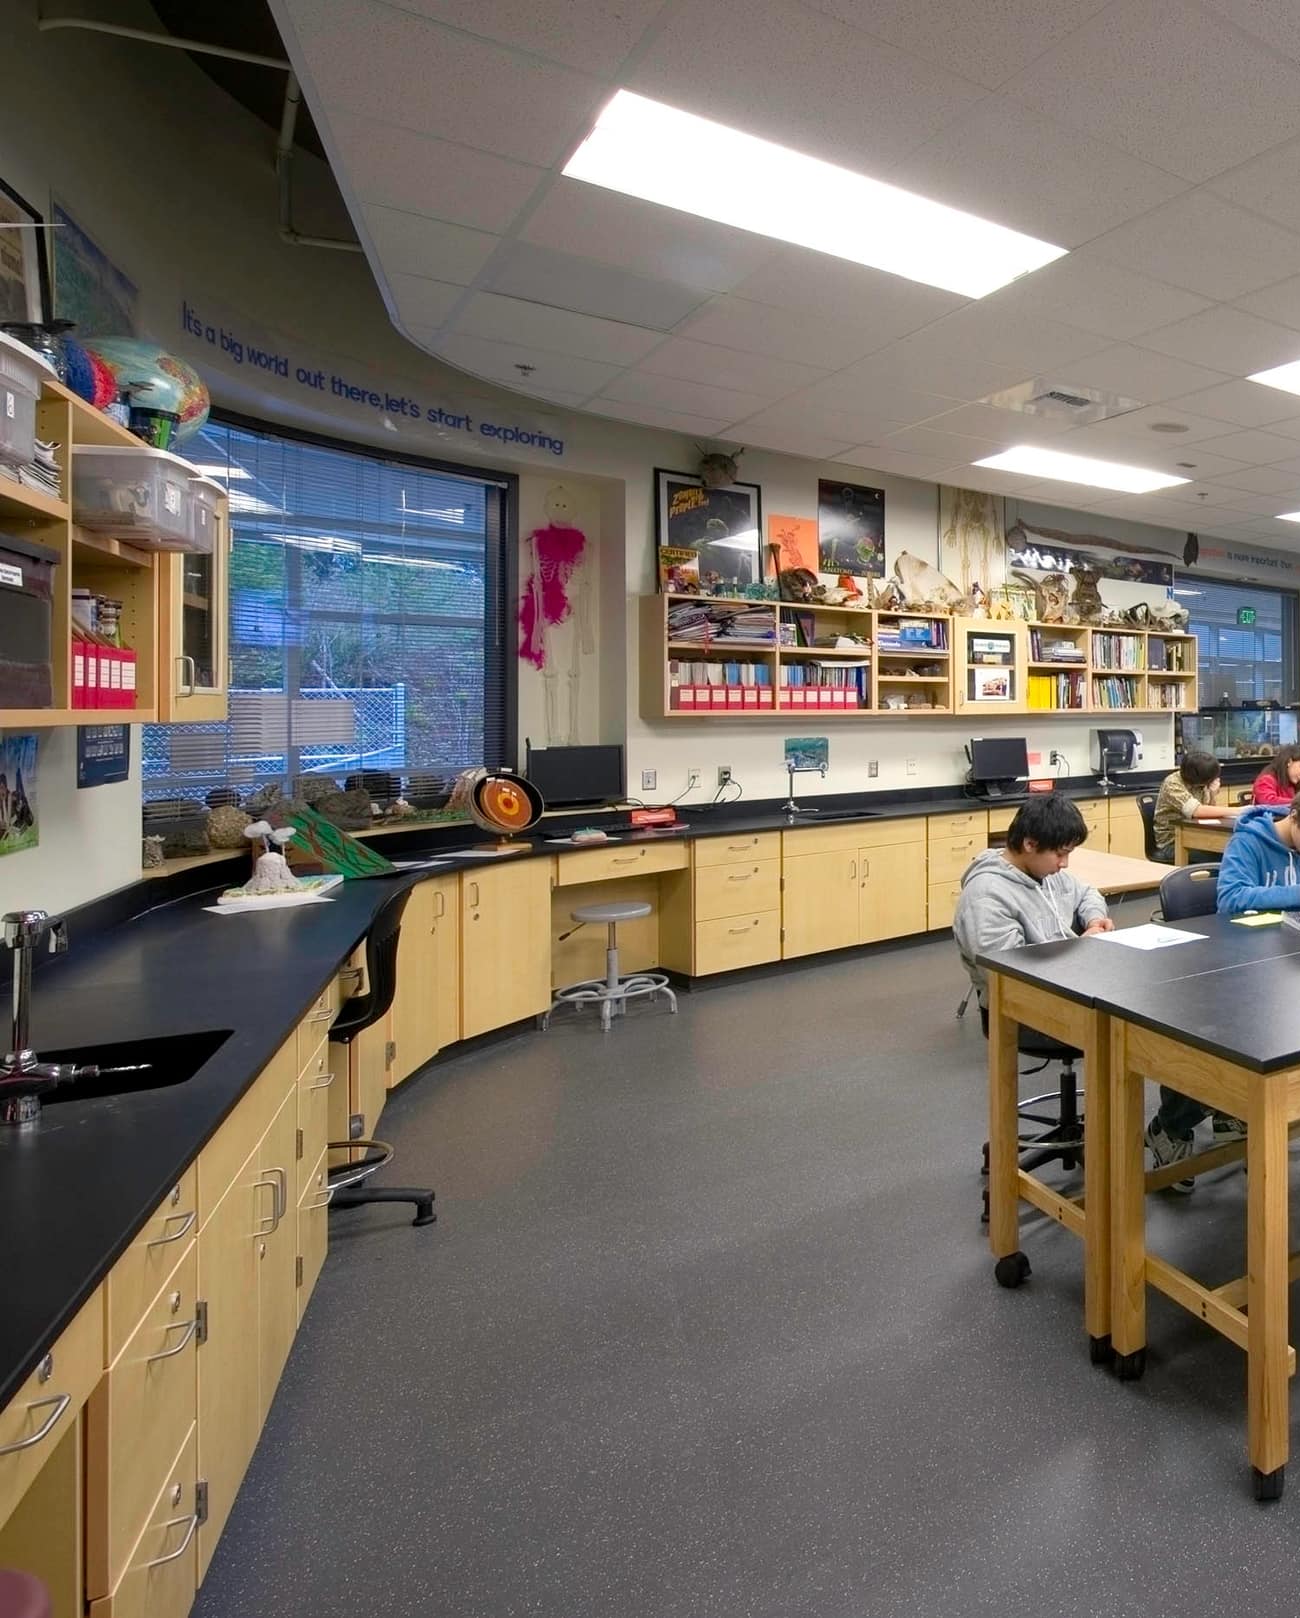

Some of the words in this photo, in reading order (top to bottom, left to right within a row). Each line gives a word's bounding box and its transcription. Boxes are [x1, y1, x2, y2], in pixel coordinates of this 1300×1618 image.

[182, 301, 202, 337] It's
[205, 327, 215, 344] a
[220, 328, 243, 363] big
[247, 346, 288, 377] world
[296, 368, 325, 390] out
[427, 408, 472, 432] start
[480, 422, 564, 455] exploring
